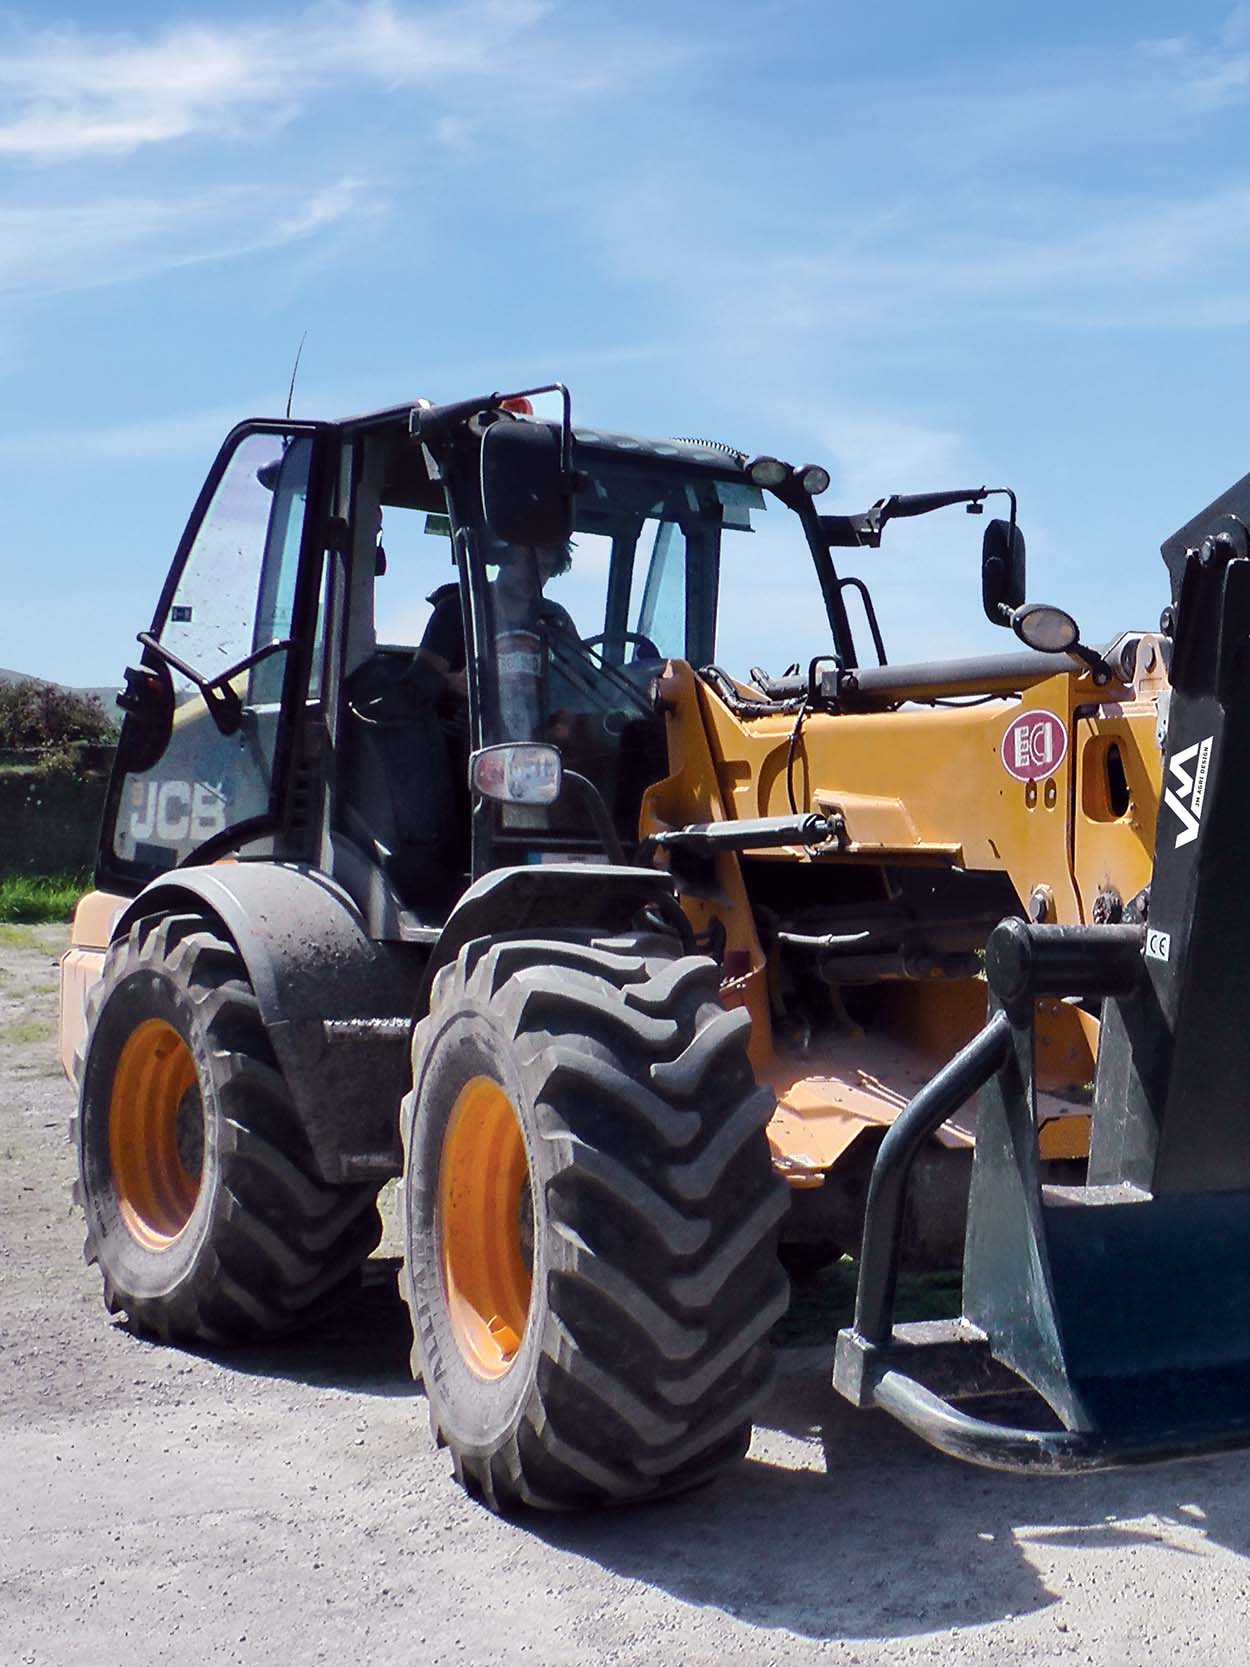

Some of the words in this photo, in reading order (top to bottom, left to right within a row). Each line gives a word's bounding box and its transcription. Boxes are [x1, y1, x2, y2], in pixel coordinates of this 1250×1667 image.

[1200, 746, 1209, 774] DESIGN
[1196, 776, 1204, 795] AGRI
[130, 780, 226, 840] JCB
[1194, 797, 1201, 808] JM
[1149, 934, 1167, 957] CE
